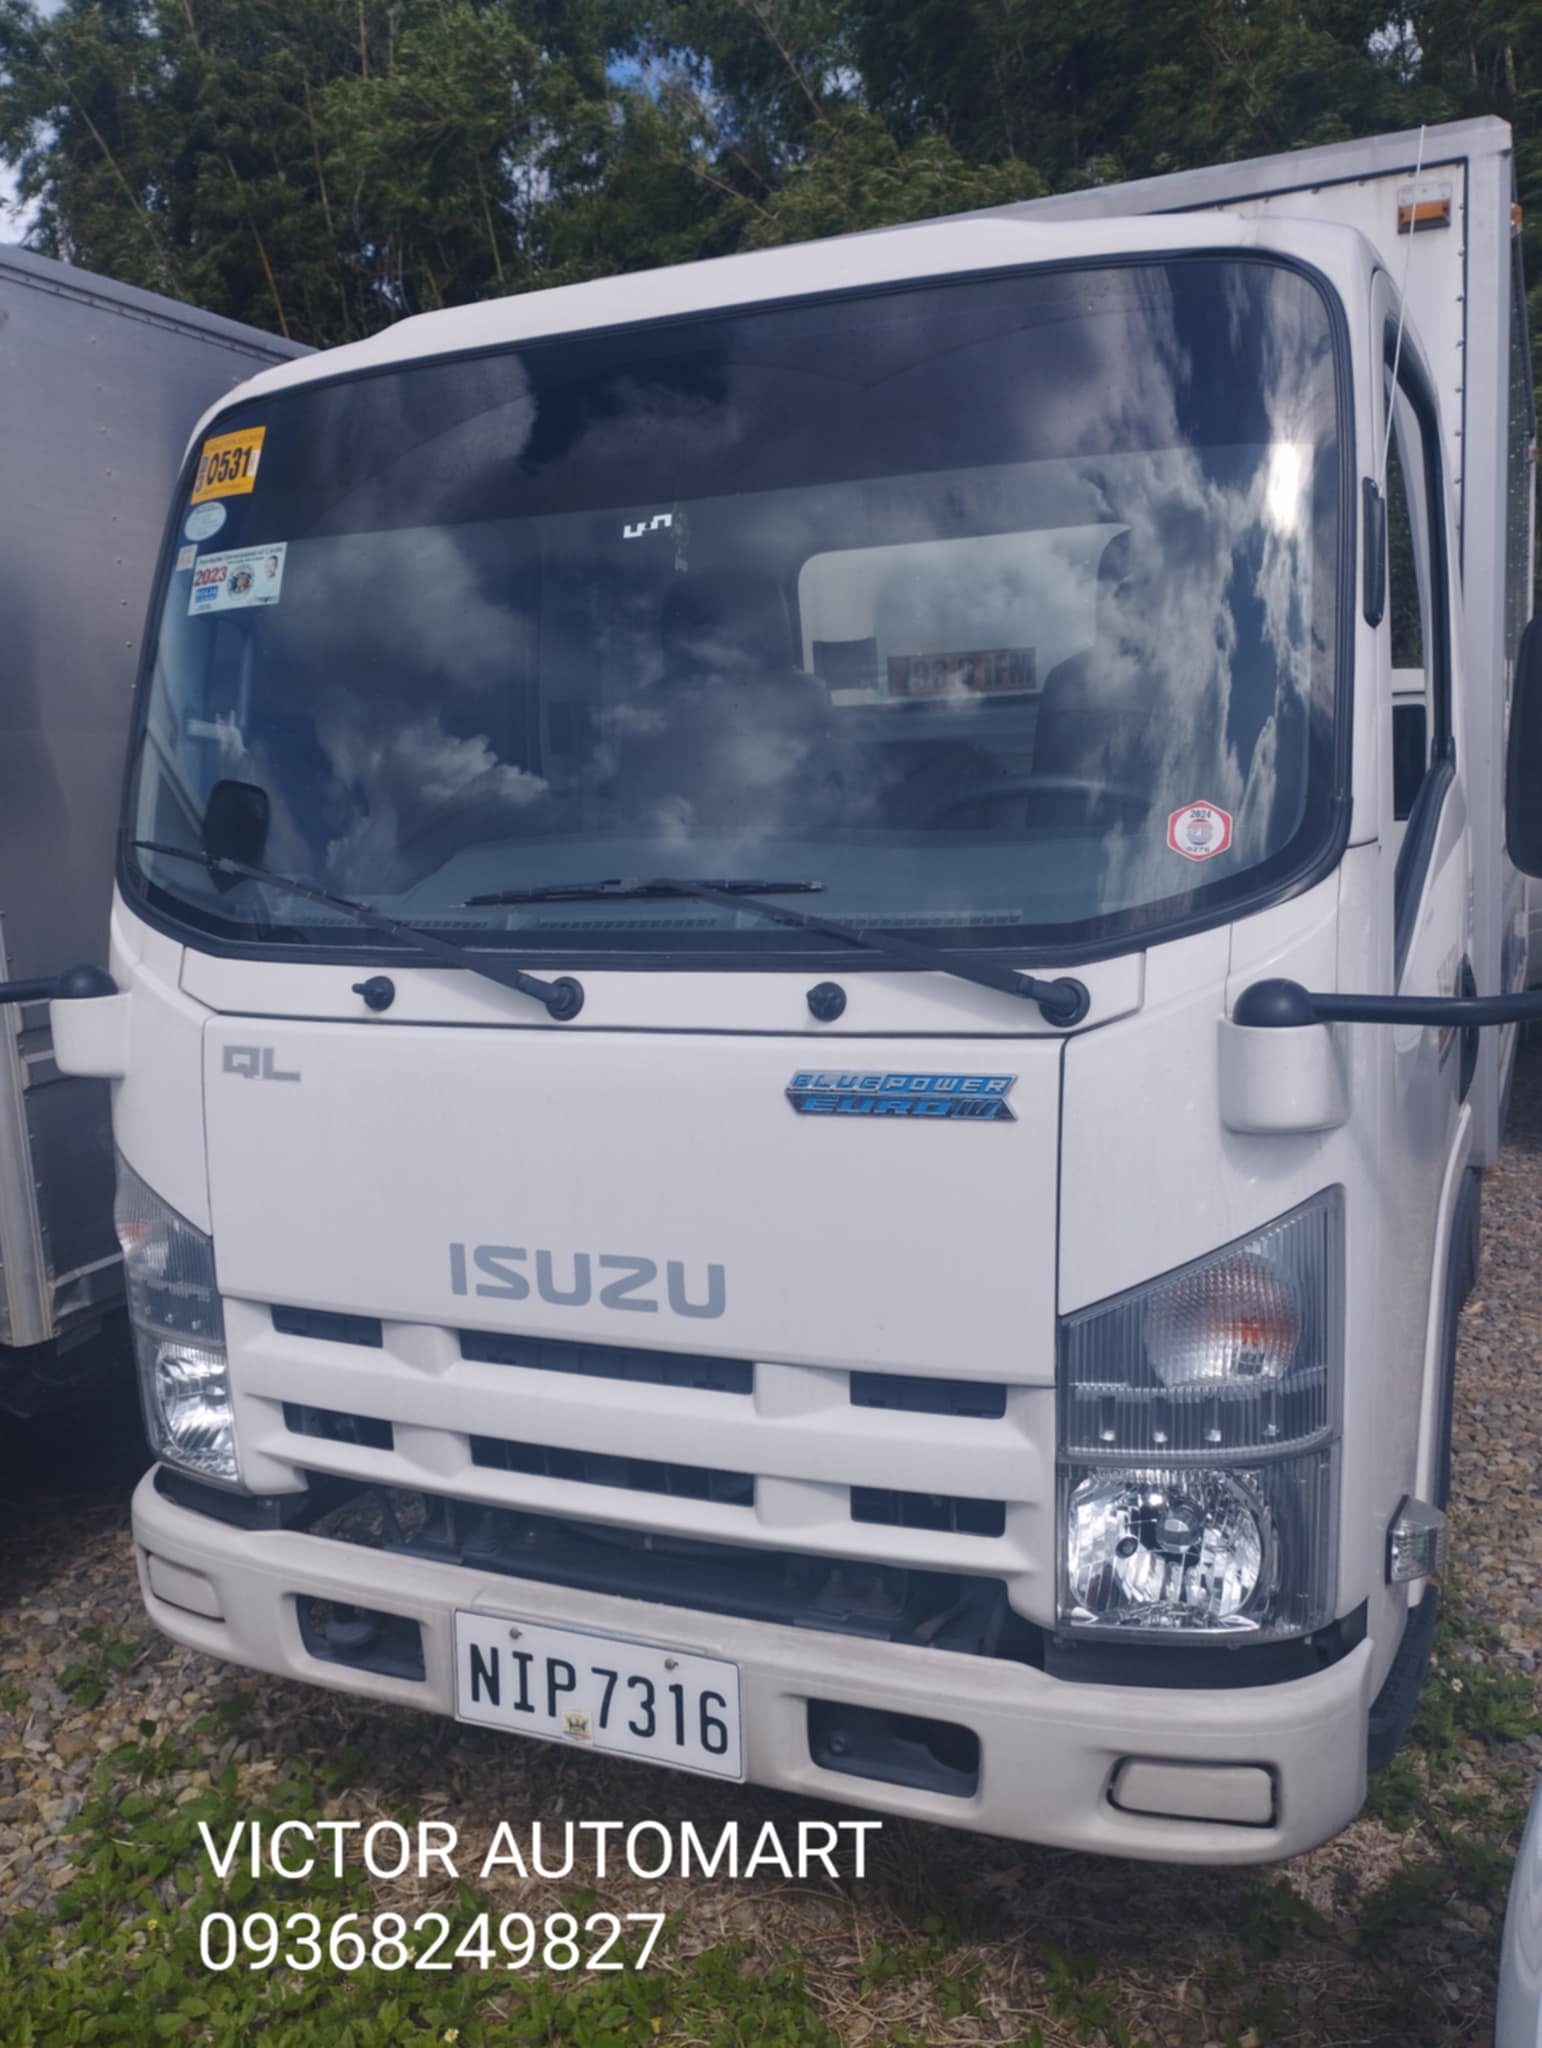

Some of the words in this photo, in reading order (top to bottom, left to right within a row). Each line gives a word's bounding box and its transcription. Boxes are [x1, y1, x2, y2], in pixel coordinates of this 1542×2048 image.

[207, 445, 253, 486] 0531
[194, 566, 228, 587] 2023
[223, 1045, 301, 1082] QL
[449, 1242, 726, 1319] ISUZU
[469, 1643, 577, 1718] NIP
[591, 1666, 728, 1755] 7316
